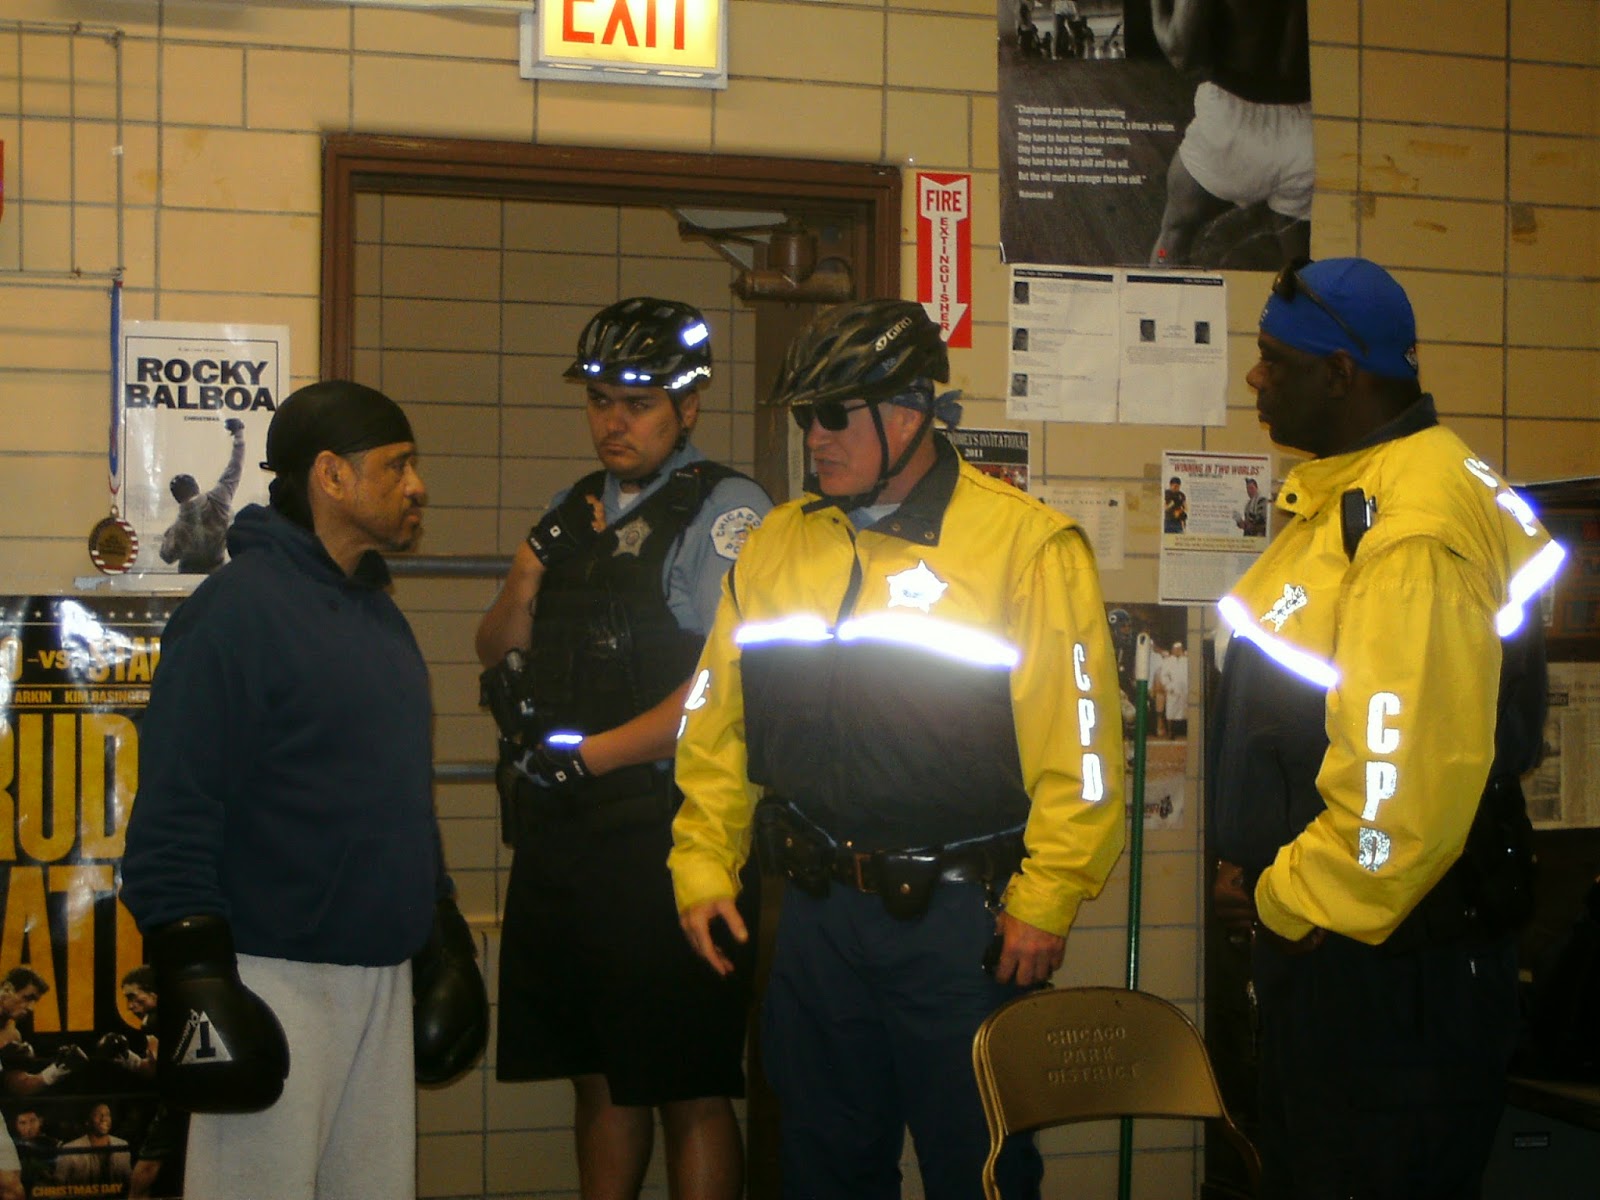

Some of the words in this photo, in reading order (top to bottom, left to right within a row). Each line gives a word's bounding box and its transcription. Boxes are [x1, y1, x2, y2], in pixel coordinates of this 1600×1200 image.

[1052, 107, 1062, 115] are
[926, 190, 962, 212] FIRE
[939, 217, 950, 331] EXTINGUISHER
[137, 357, 268, 385] ROCKY
[126, 383, 276, 412] BALBOA
[964, 448, 983, 458] 2011
[716, 511, 760, 537] CHICAGO
[65, 690, 88, 703] KIM
[1074, 643, 1103, 802] CPD
[1358, 692, 1400, 872] CPD
[1045, 1027, 1126, 1044] CHICAGO
[1064, 1046, 1114, 1063] PARK
[1048, 1064, 1139, 1083] DISTRICT
[32, 1184, 99, 1197] CHRISTMAS
[101, 1183, 123, 1194] DAY
